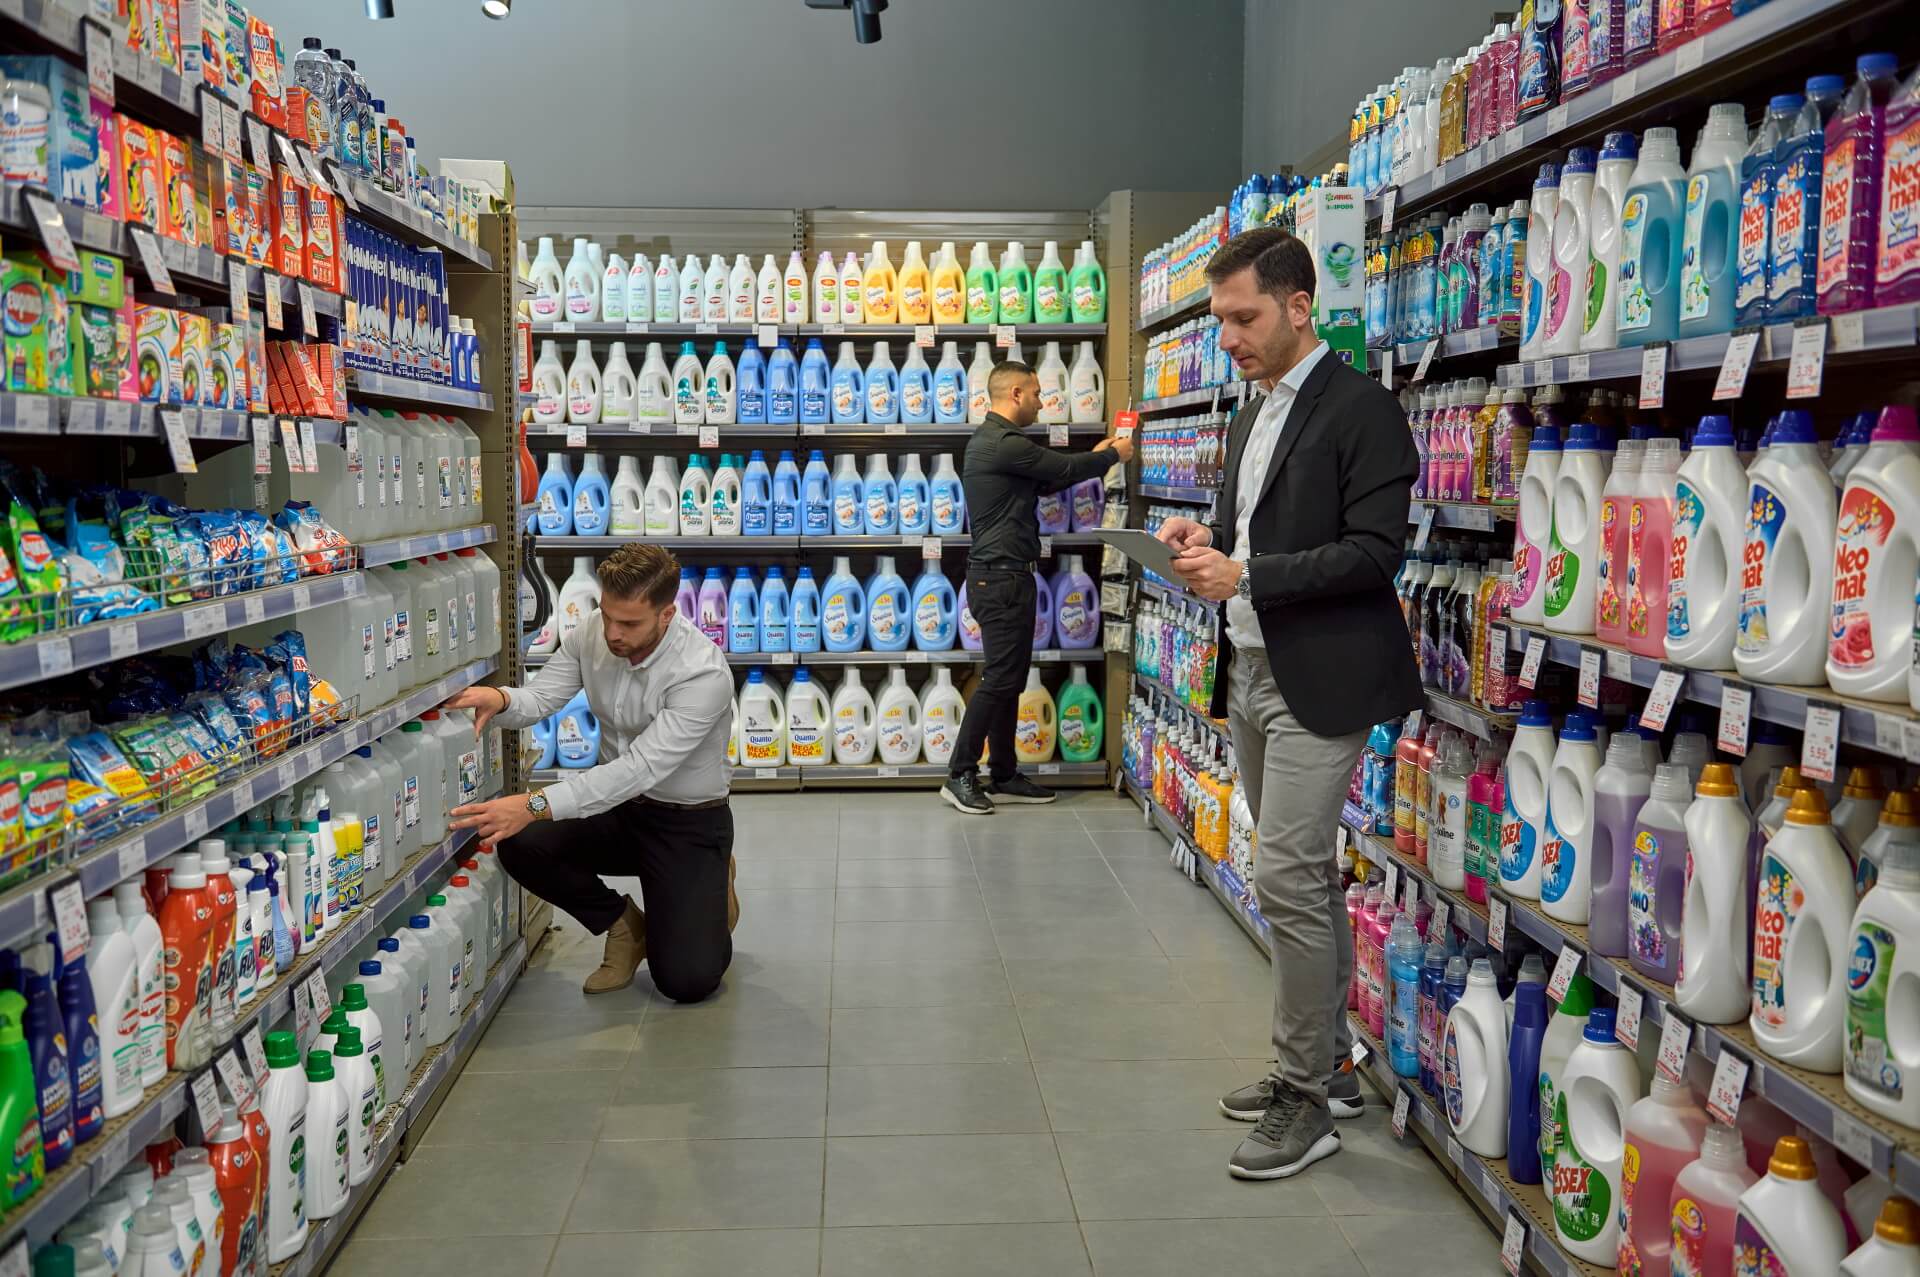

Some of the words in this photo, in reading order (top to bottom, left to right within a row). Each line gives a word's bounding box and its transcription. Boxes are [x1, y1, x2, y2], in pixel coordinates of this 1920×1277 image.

[1776, 189, 1803, 215] Neo
[1823, 177, 1849, 202] Neo
[1742, 204, 1766, 227] Neo
[1776, 209, 1801, 236] mat
[1823, 197, 1847, 228] mat
[1742, 225, 1766, 249] mat
[1835, 547, 1869, 573] Neo
[1834, 574, 1867, 601] mat
[750, 735, 772, 745] Quanto
[794, 734, 816, 744] Quanto
[1571, 1195, 1592, 1209] Multi
